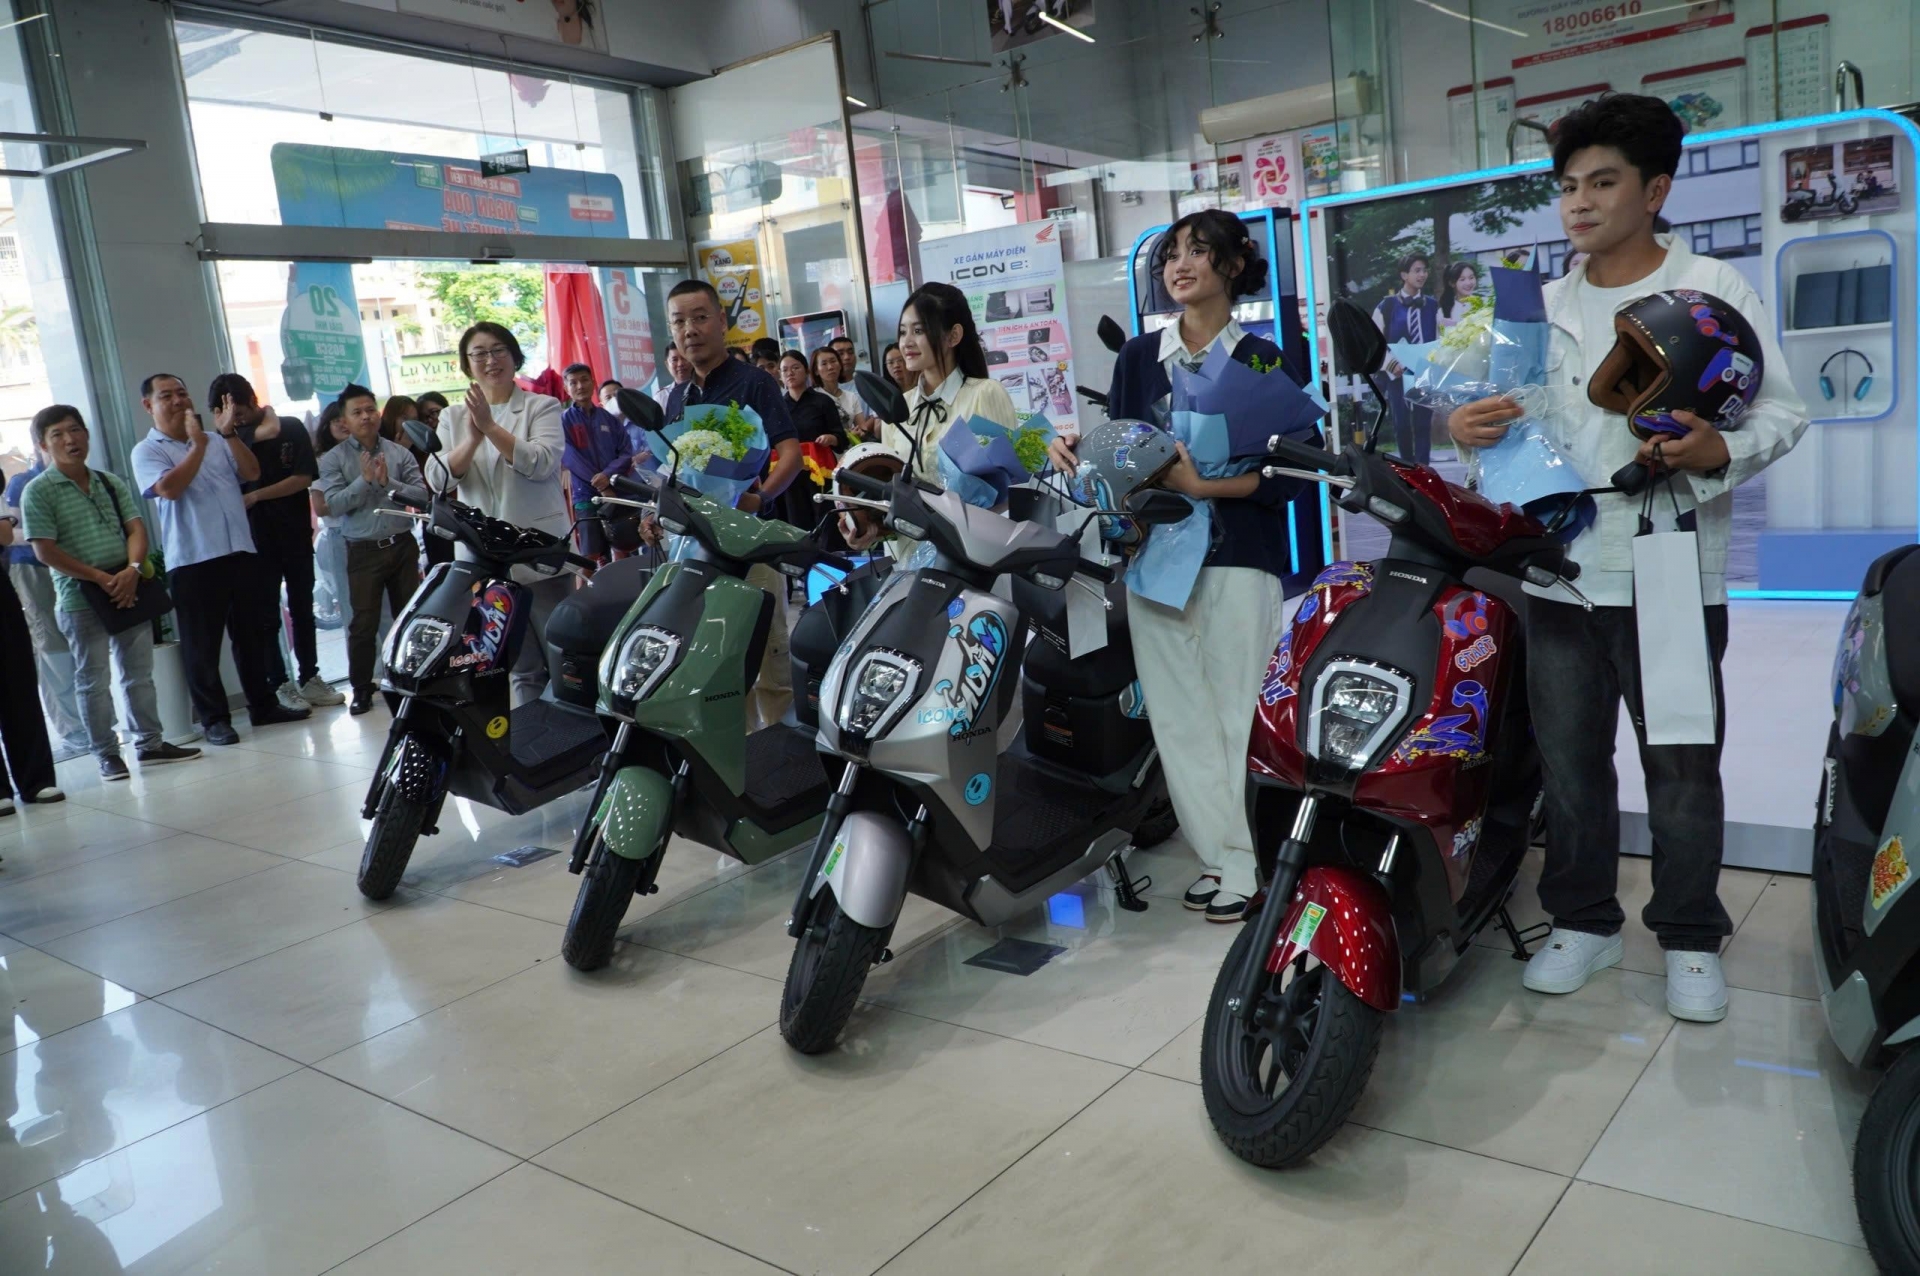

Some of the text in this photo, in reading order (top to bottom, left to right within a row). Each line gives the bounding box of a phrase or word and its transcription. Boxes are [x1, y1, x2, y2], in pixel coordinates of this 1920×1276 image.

[1543, 0, 1641, 35] 18006610
[954, 256, 964, 265] XE
[985, 247, 1004, 259] MÁY
[1006, 245, 1026, 257] ĐIỆN
[950, 262, 1005, 281] ICON
[1010, 259, 1029, 271] e:
[401, 365, 418, 377] Lu
[421, 362, 441, 375] Yu
[921, 577, 946, 589] HONDA
[1389, 570, 1428, 584] HONDA
[1455, 635, 1497, 672] START
[704, 690, 741, 703] HONDA
[952, 726, 992, 742] HONDA
[1461, 754, 1494, 771] HONDA
